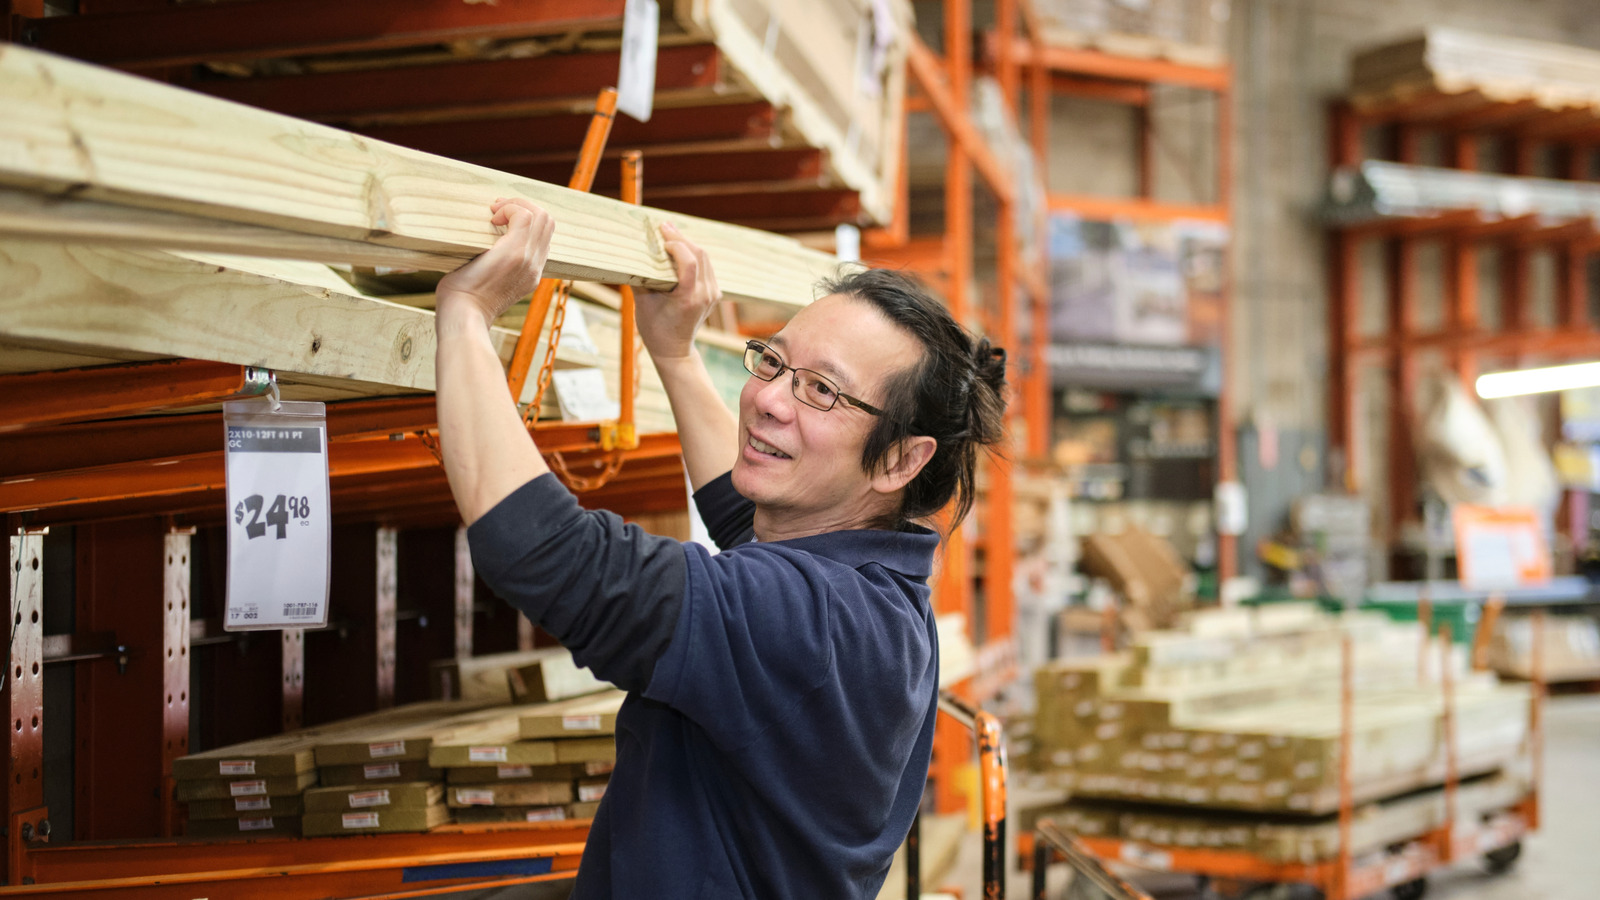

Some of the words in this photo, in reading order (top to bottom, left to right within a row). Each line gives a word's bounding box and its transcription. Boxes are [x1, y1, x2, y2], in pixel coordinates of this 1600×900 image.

[229, 430, 276, 439] 2X10-12FT
[292, 431, 303, 439] PT
[229, 440, 242, 448] GC
